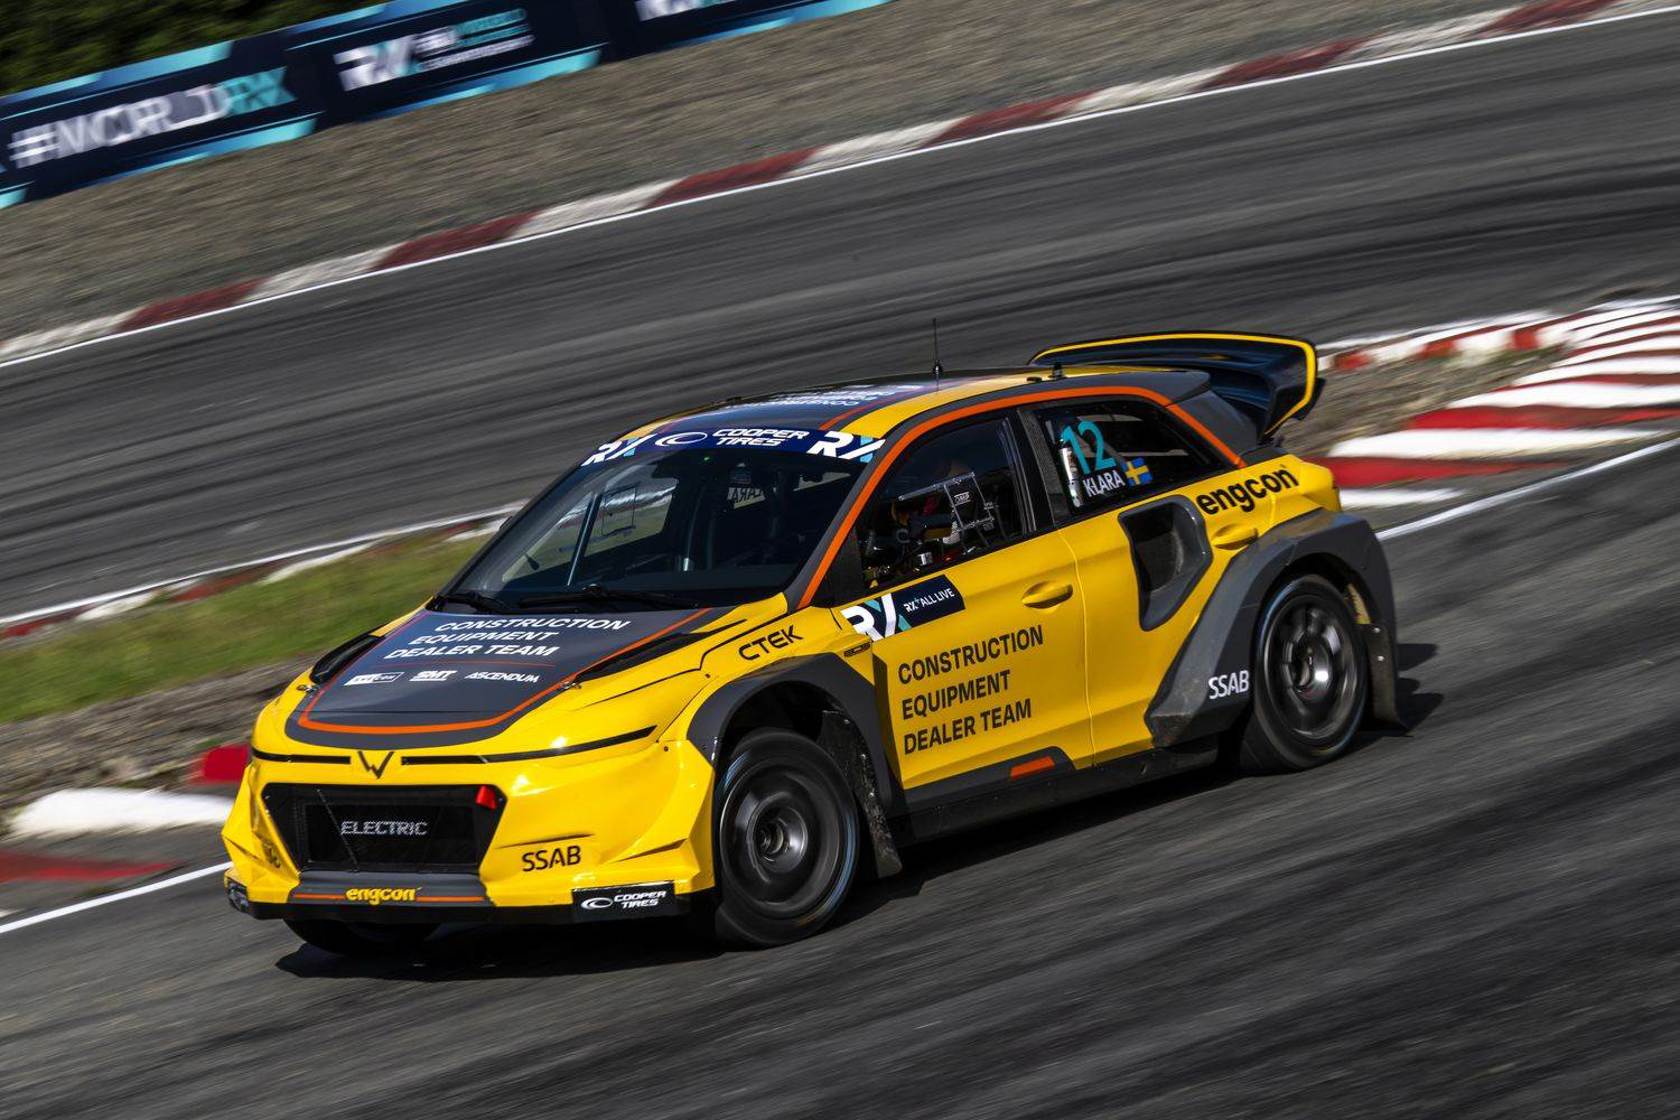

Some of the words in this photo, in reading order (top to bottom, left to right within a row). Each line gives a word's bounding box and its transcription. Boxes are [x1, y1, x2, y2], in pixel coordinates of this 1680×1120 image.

[712, 428, 810, 440] COOPER
[716, 437, 786, 447] TIRES
[1060, 420, 1117, 475] 12
[1082, 469, 1126, 498] KLARA
[1196, 469, 1299, 515] engcon
[934, 588, 955, 601] LIVE
[434, 618, 631, 632] CONSTRUCTION
[408, 631, 560, 645] EQUIPMENT
[738, 624, 804, 661] CTEK
[383, 645, 482, 660] DEALER
[483, 645, 560, 656] TEAM
[898, 624, 1044, 685] CONSTRUCTION
[464, 671, 540, 683] ASCENDUM
[1208, 669, 1250, 700] SSAB
[902, 670, 1011, 720] EQUIPMENT
[904, 716, 976, 755] DEALER
[980, 698, 1032, 732] TEAM
[340, 821, 428, 836] ELECTRIC
[522, 845, 582, 872] SSAB
[345, 888, 417, 906] engcon
[614, 890, 667, 903] COOPER
[620, 898, 659, 909] TIRES
